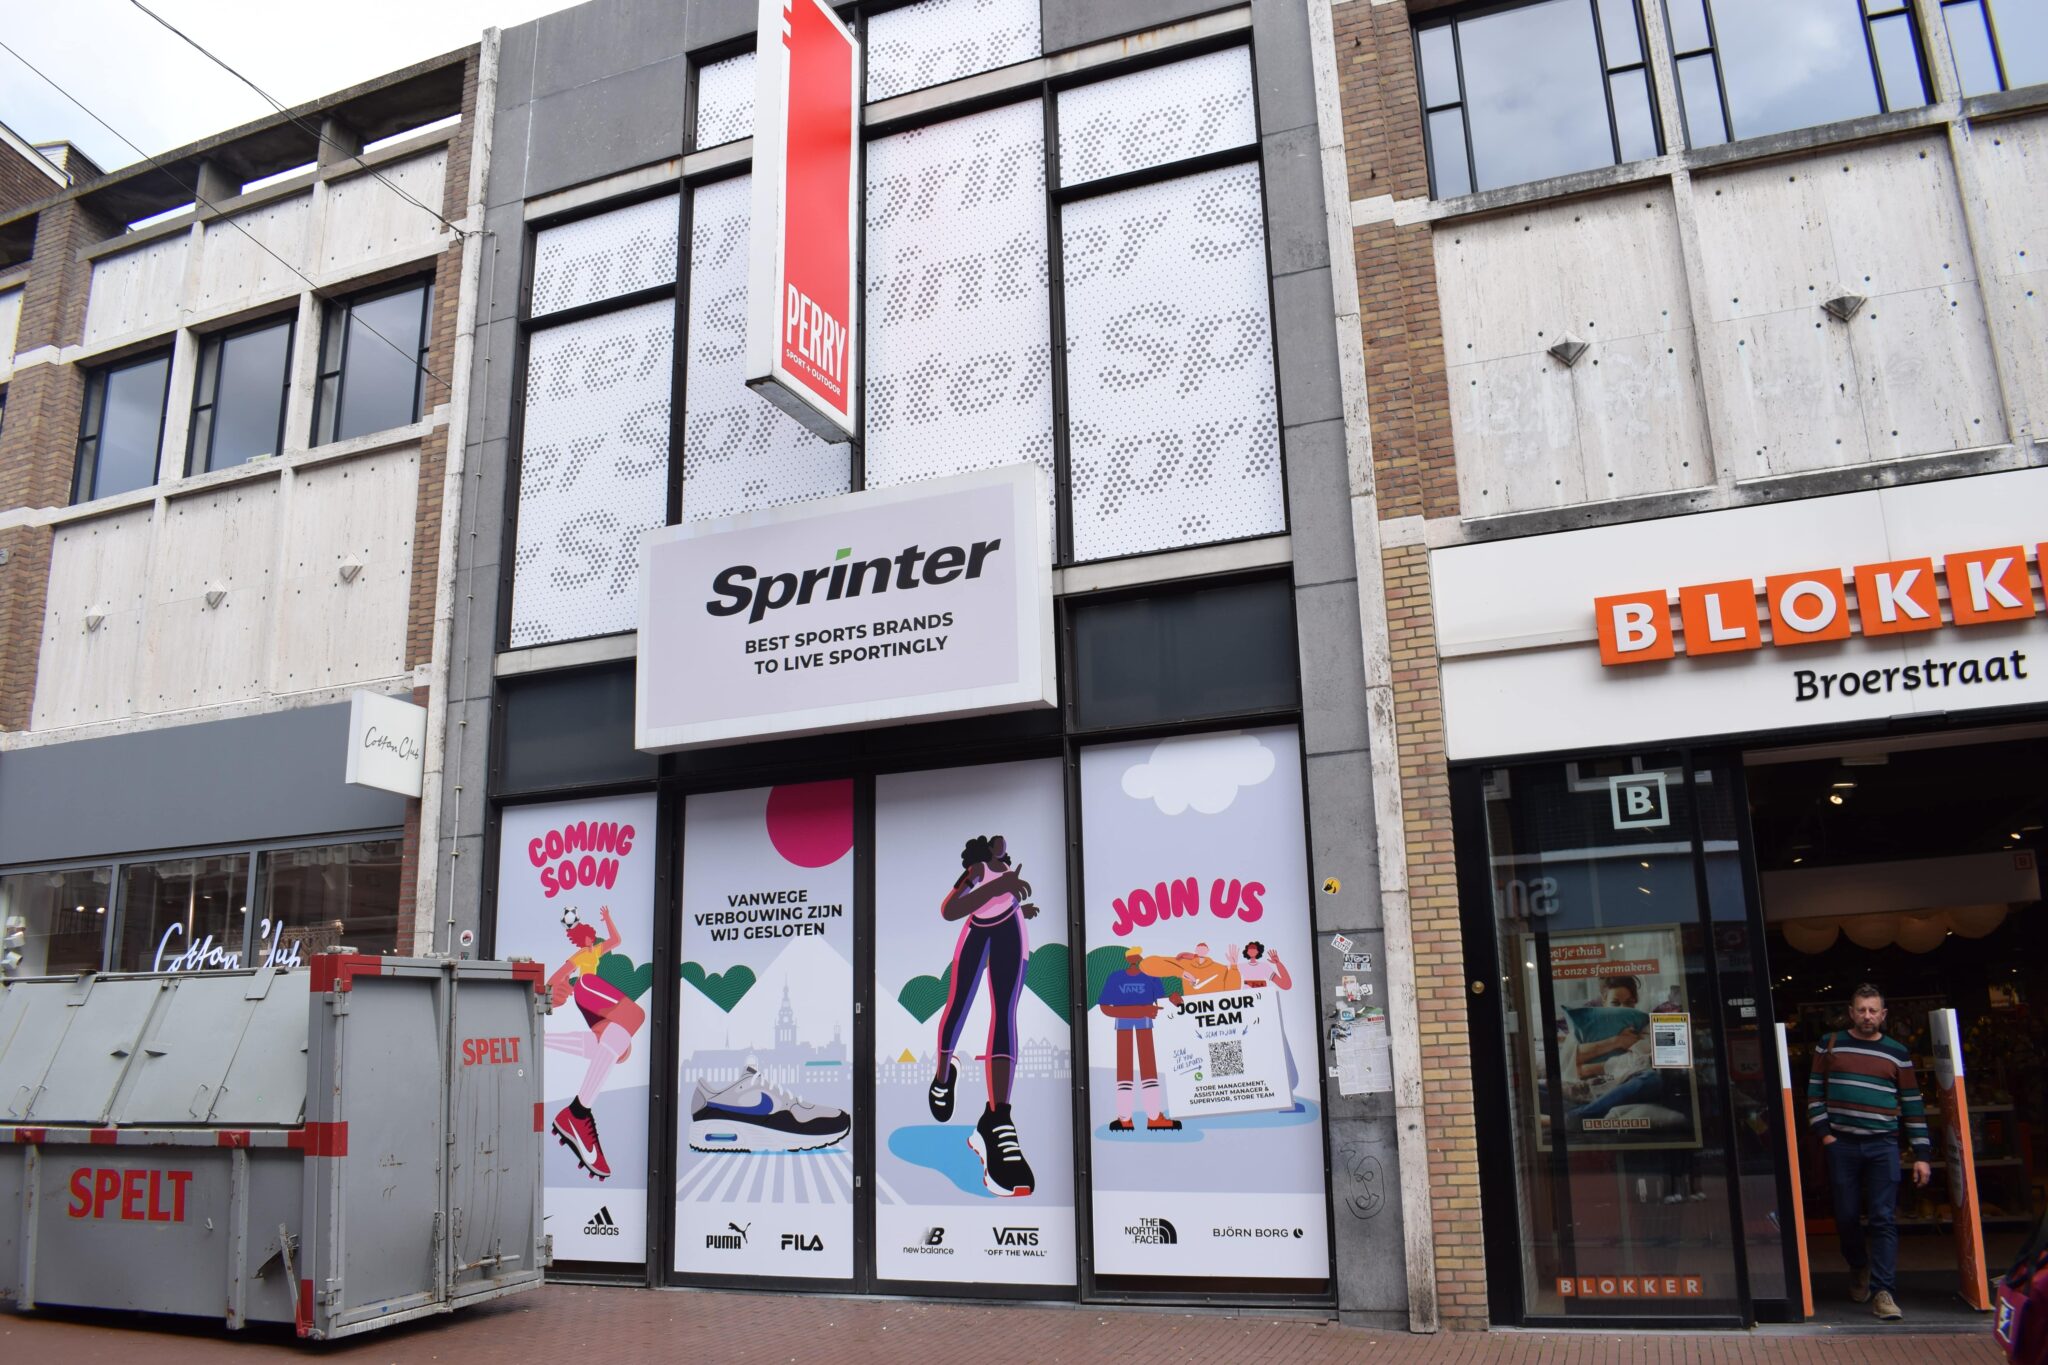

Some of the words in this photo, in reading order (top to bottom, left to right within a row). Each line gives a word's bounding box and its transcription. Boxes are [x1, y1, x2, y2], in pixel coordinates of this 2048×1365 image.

[787, 283, 846, 382] PERRY
[786, 349, 806, 369] SPORT
[812, 368, 842, 396] OUTDOOR
[706, 538, 1002, 624] Sprinter
[745, 635, 790, 655] BEST
[794, 624, 867, 648] SPORTS
[873, 612, 954, 636] BRANDS
[754, 657, 778, 675] TO
[784, 653, 824, 672] LIVE
[829, 636, 948, 666] SPORTINGLY
[1794, 650, 2028, 702] Broerstraat
[365, 726, 398, 752] Cotton
[399, 736, 419, 760] Club
[528, 821, 636, 868] COMING
[540, 855, 619, 898] SOON
[728, 890, 808, 907] VANWEGE
[1112, 876, 1200, 937] JOIN
[1209, 878, 1266, 923] US
[695, 907, 803, 926] VERBOUWING
[807, 904, 843, 919] ZIJN
[711, 928, 739, 942] WIJ
[744, 922, 825, 940] GESLOTEN
[1576, 946, 1602, 956] thuis
[1564, 966, 1588, 976] onze
[1590, 962, 1655, 977] sfeermakers.
[1177, 999, 1214, 1016] JOIN
[1218, 995, 1254, 1011] OUR
[1195, 1011, 1243, 1028] TEAM
[462, 1037, 521, 1066] SPELT
[1194, 1089, 1229, 1098] ASSISTANT
[1230, 1086, 1263, 1096] MANAGER
[1195, 1083, 1217, 1092] STORE
[1217, 1080, 1267, 1090] MANAGEMENT,
[1233, 1093, 1255, 1102] STORE
[1256, 1091, 1275, 1100] TEAM
[1584, 1119, 1649, 1129] BLOKKER
[67, 1167, 193, 1223] SPELT
[583, 1225, 620, 1236] adidas
[1125, 1226, 1159, 1236] NORTH
[1139, 1218, 1159, 1227] THE
[1134, 1235, 1159, 1245] FACE
[1212, 1226, 1252, 1238] BJÖRN
[1255, 1228, 1289, 1238] BORG
[706, 1235, 742, 1249] PUMA
[781, 1234, 824, 1251] FILA
[902, 1246, 919, 1254] new
[920, 1246, 955, 1255] balance
[1006, 1249, 1021, 1257] THE
[1560, 1279, 1699, 1294] BLOKKER
